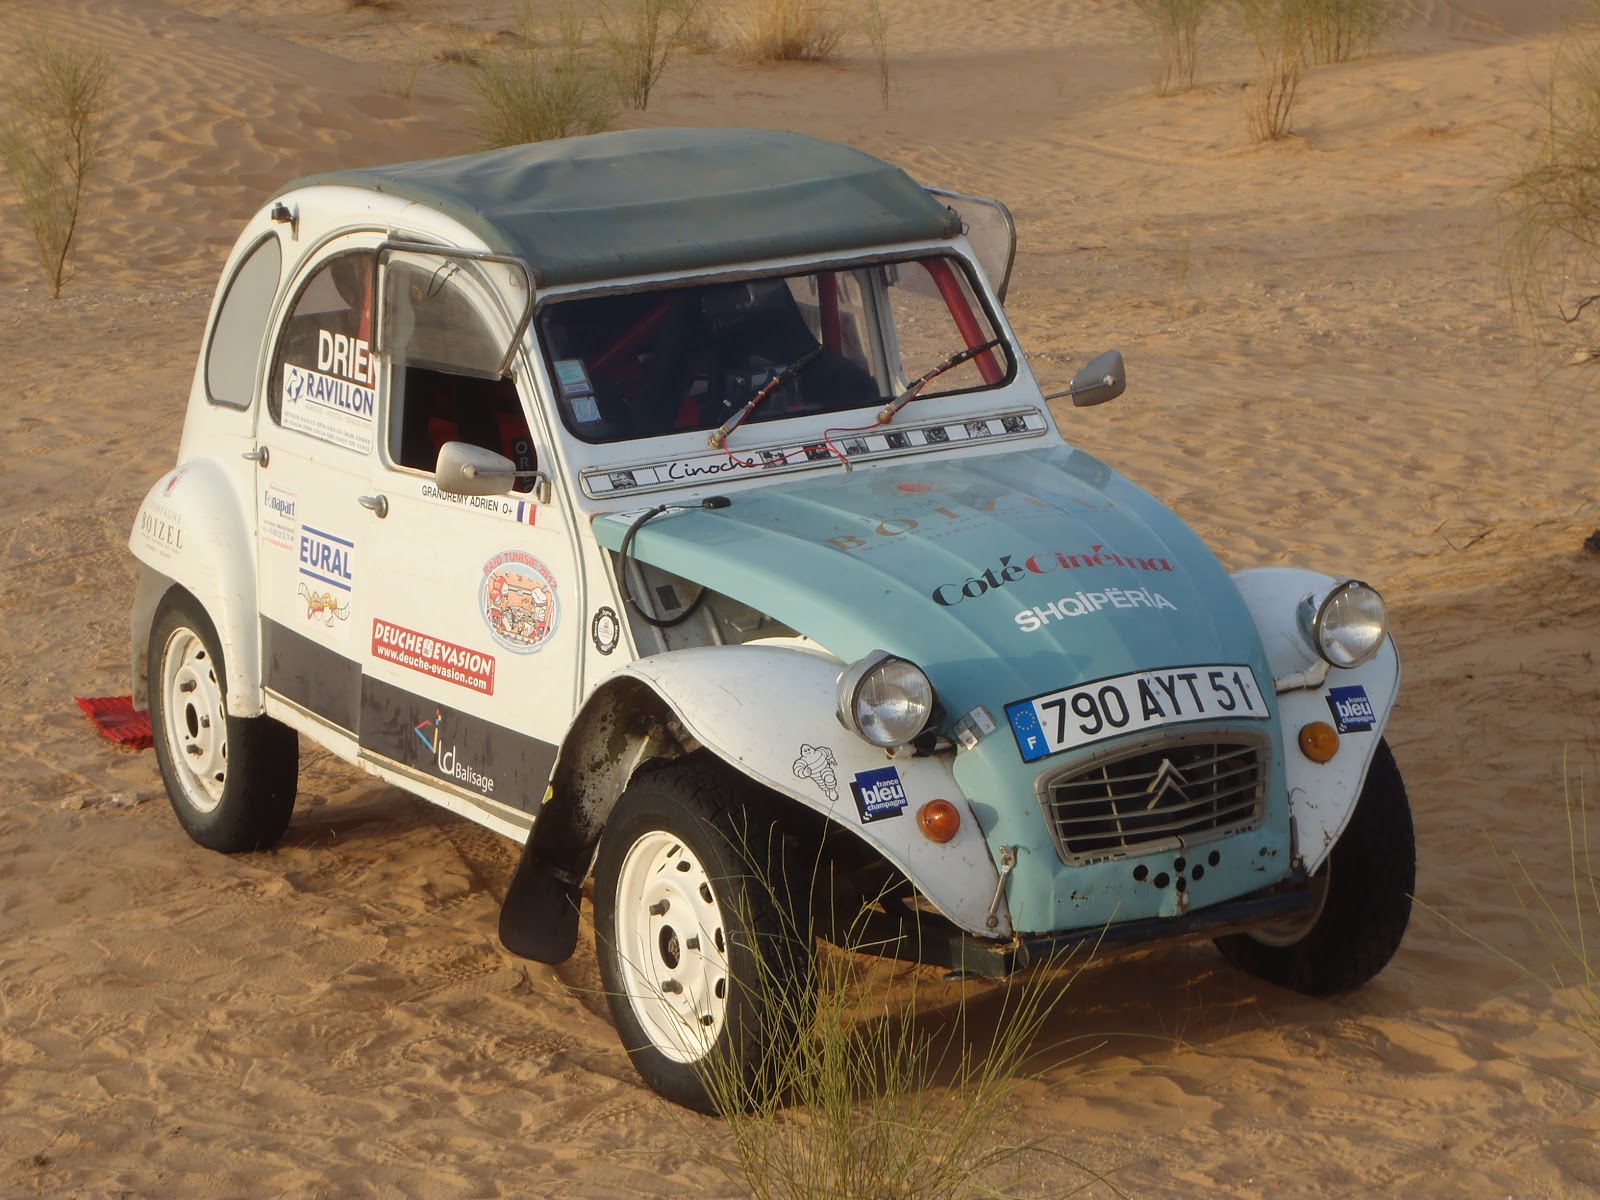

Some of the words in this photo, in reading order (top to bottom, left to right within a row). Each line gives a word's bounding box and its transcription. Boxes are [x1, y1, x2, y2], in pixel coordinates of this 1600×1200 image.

[306, 373, 374, 418] RAVILLON
[668, 454, 755, 481] Cinoche
[421, 485, 469, 506] GRANDREMY
[470, 496, 499, 512] ADRIEN
[141, 511, 184, 549] BOIZEL
[299, 536, 352, 580] EURAL
[483, 555, 502, 576] RAID
[504, 552, 538, 569] TUNISIE
[538, 563, 558, 590] 2012
[375, 624, 421, 653] DEUCHE
[433, 643, 493, 676] EVASION
[377, 645, 487, 691] www.deuche-evasion.com
[1042, 685, 1130, 744] 790
[1138, 673, 1205, 721] AYT
[1208, 671, 1254, 711] 51
[1336, 700, 1372, 717] bleu
[1027, 736, 1039, 750] F
[456, 763, 494, 793] Balisage
[876, 778, 899, 788] france
[861, 785, 904, 804] bleu
[867, 799, 906, 812] champagne
